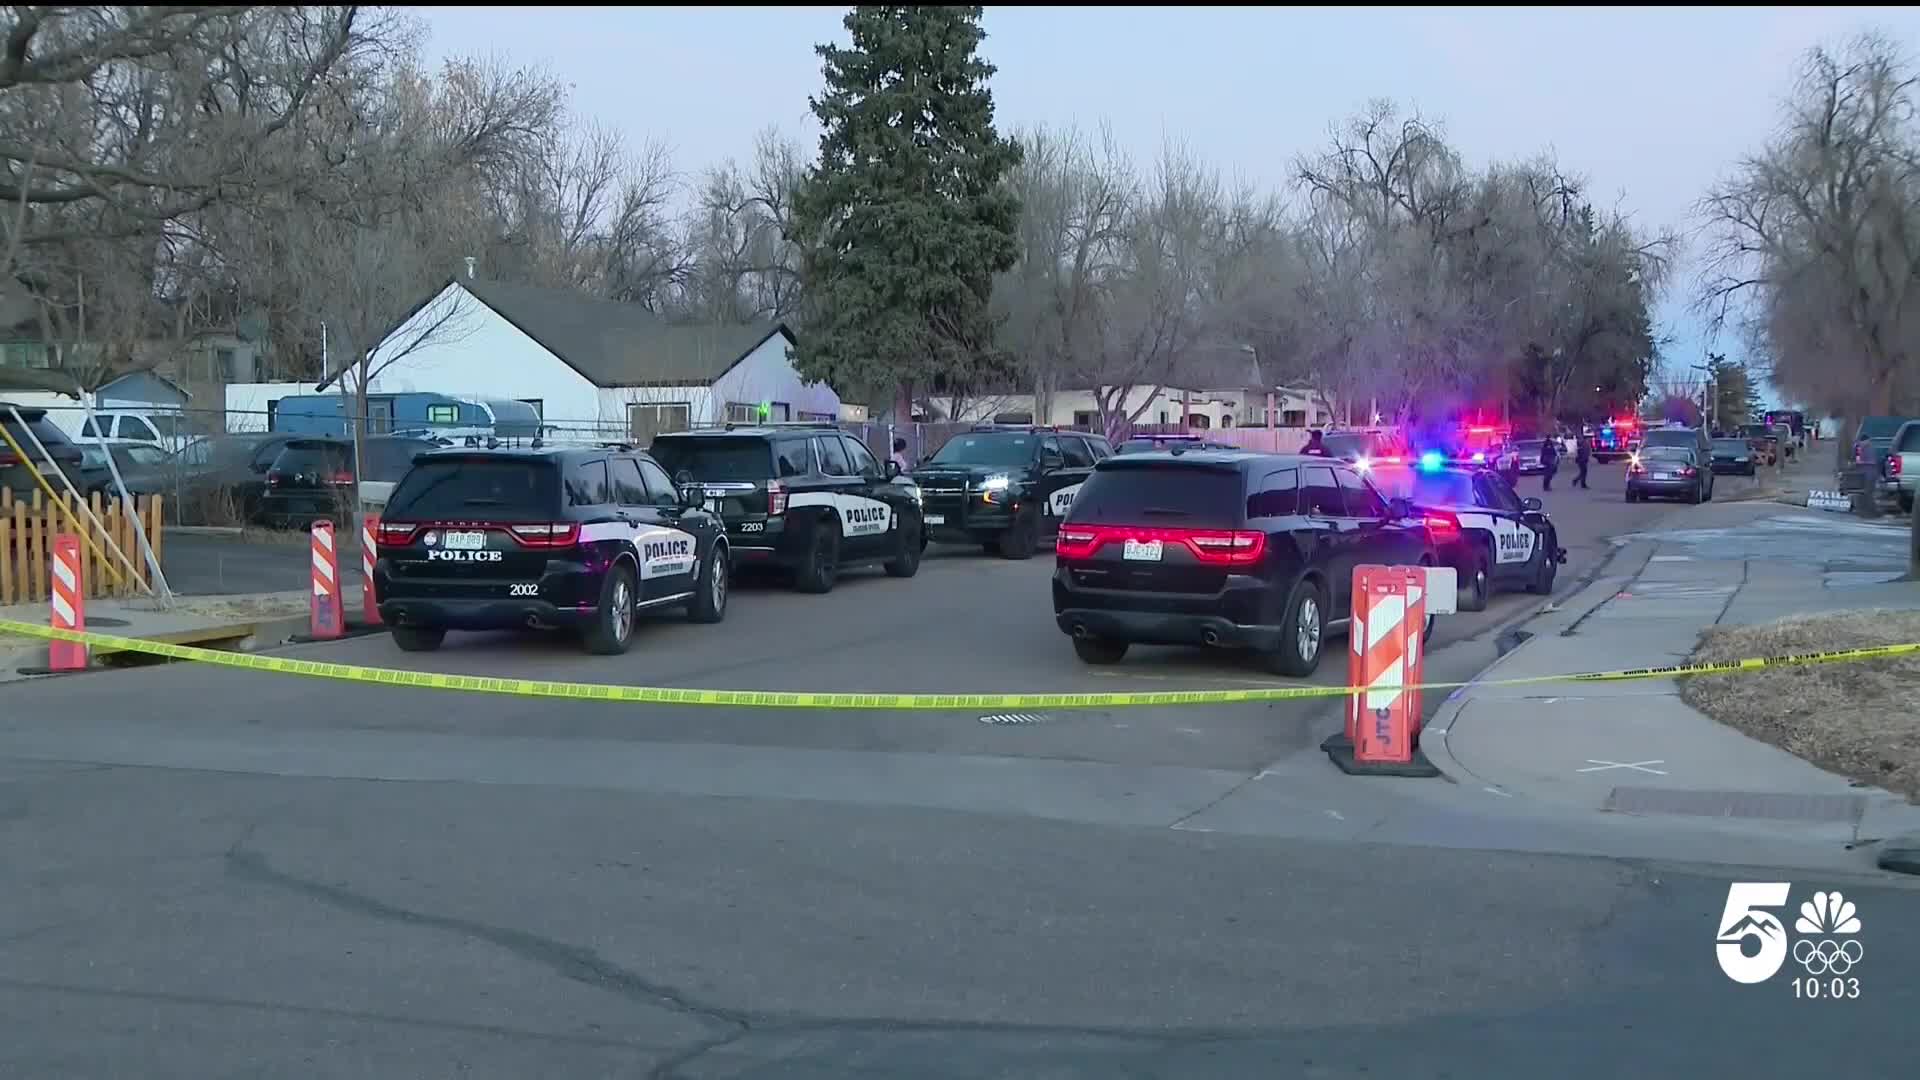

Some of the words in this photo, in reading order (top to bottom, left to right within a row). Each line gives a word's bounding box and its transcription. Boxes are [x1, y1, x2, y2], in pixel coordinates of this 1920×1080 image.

[846, 507, 886, 523] POLICE
[741, 523, 763, 532] 2203
[1500, 533, 1529, 550] POLICE
[427, 549, 503, 562] POLICE
[644, 540, 689, 562] POLICE
[509, 583, 539, 596] 2002
